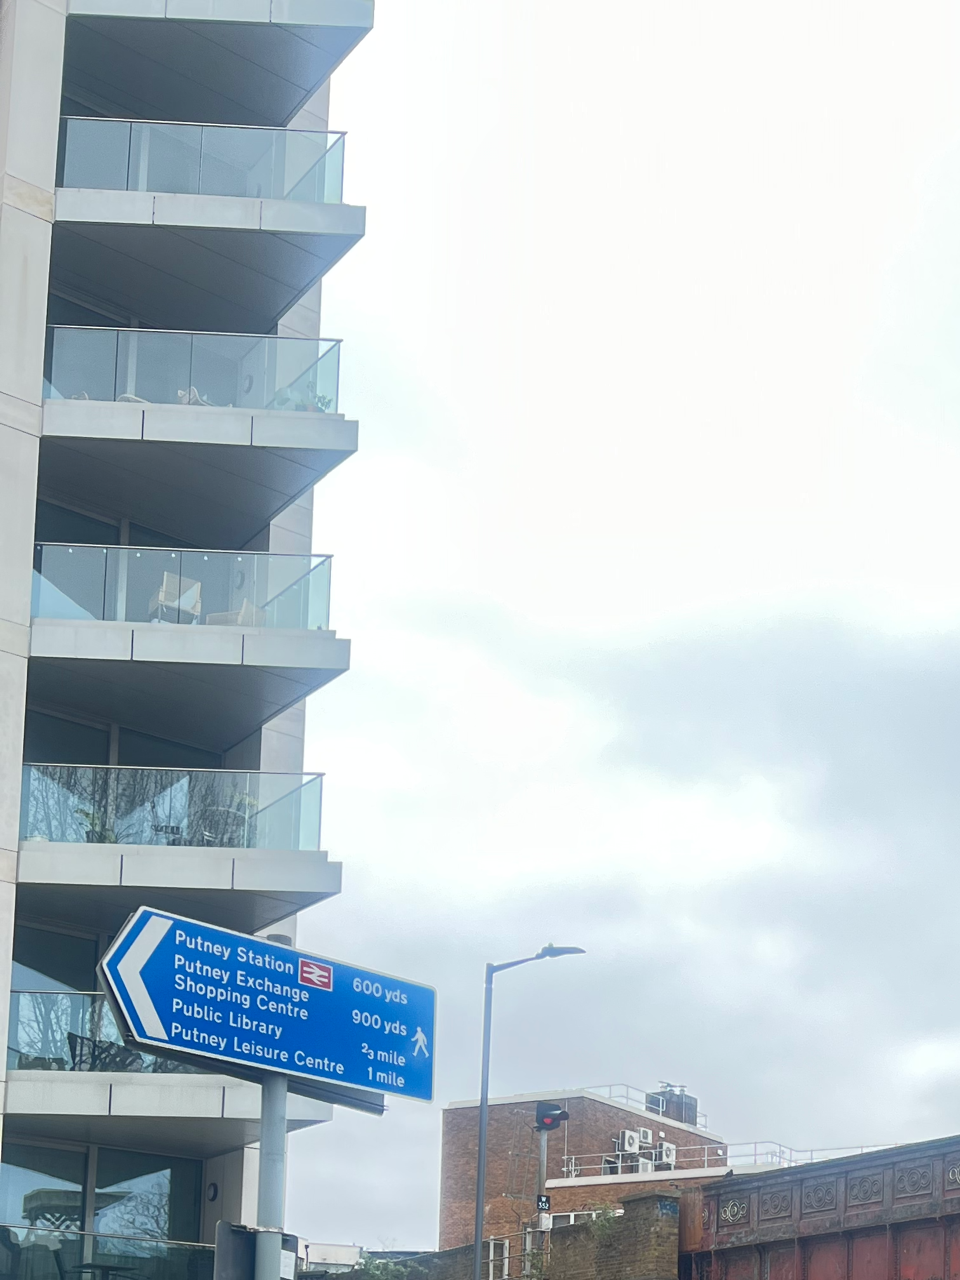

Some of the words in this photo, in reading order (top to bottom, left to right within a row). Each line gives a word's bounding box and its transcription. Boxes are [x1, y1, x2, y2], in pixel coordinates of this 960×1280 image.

[174, 954, 230, 984] Putney
[236, 970, 310, 1002] Exchange
[175, 929, 231, 960] Putney
[237, 947, 294, 975] Station
[352, 977, 382, 997] 600
[384, 989, 408, 1005] yds
[172, 998, 222, 1023] Public
[229, 1011, 282, 1040] Library
[377, 1050, 406, 1067] mile
[174, 974, 250, 1009] Shopping
[256, 994, 309, 1020] Centre
[352, 1009, 381, 1029] 900
[384, 1020, 407, 1036] yds
[171, 1022, 227, 1051] Putney
[233, 1036, 289, 1062] Leisure
[294, 1050, 345, 1075] Centre
[367, 1066, 373, 1080] 1
[376, 1070, 405, 1087] mile
